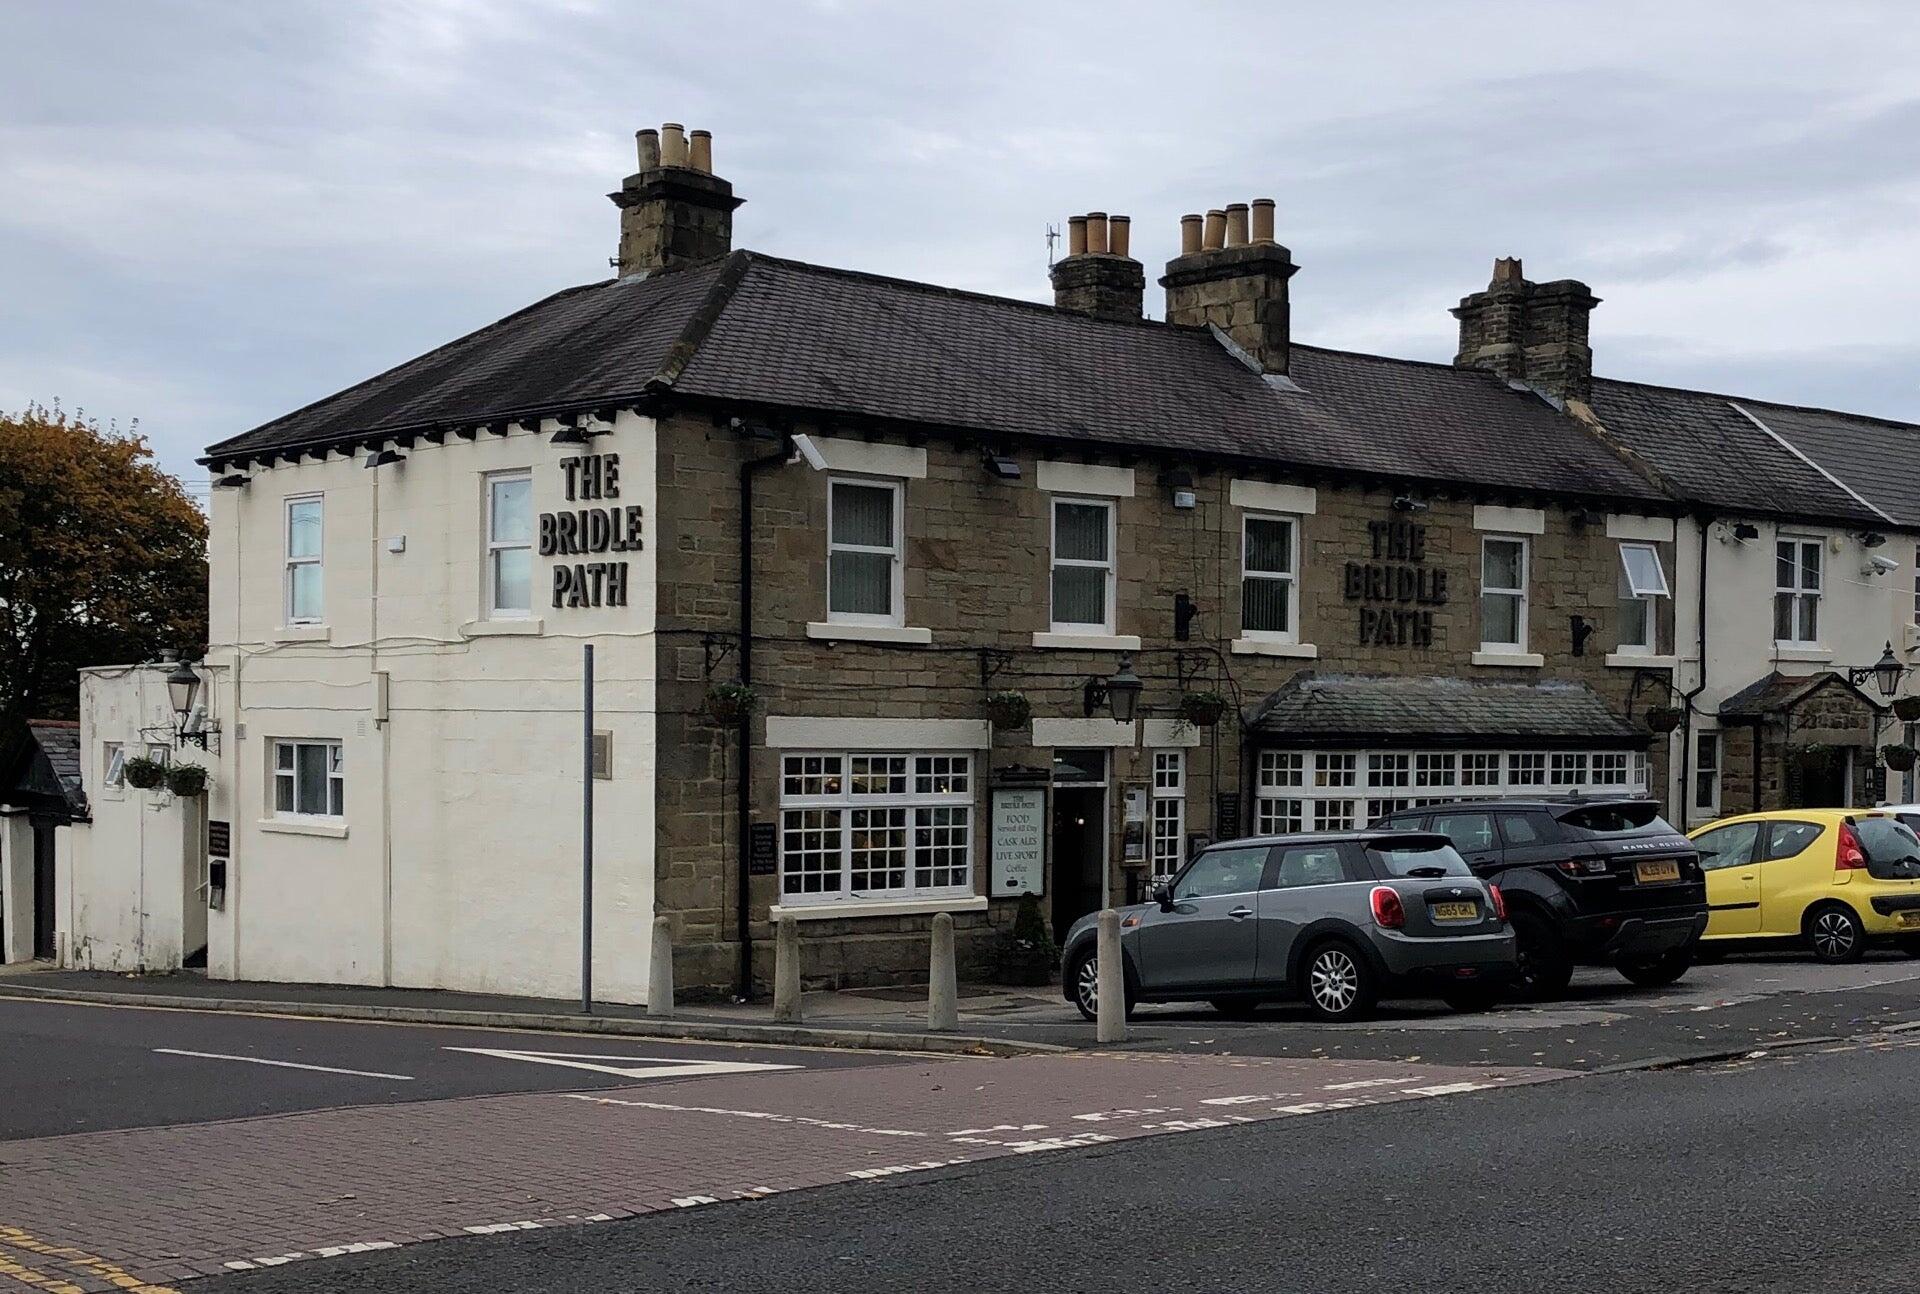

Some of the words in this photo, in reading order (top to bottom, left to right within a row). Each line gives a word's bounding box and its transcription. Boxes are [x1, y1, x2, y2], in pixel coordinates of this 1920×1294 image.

[560, 453, 620, 501] THE
[538, 505, 643, 556] BRIDLE
[1368, 521, 1425, 559] THE
[552, 562, 628, 608] PATH
[1345, 561, 1448, 605] BRIDLE
[1360, 608, 1433, 646] PATH
[1006, 814, 1030, 824] FOOD
[996, 851, 1014, 861] LIVE
[1014, 850, 1039, 860] SPORT
[997, 837, 1018, 847] CASK
[1019, 836, 1038, 846] ALES
[1005, 864, 1027, 873] Coffee
